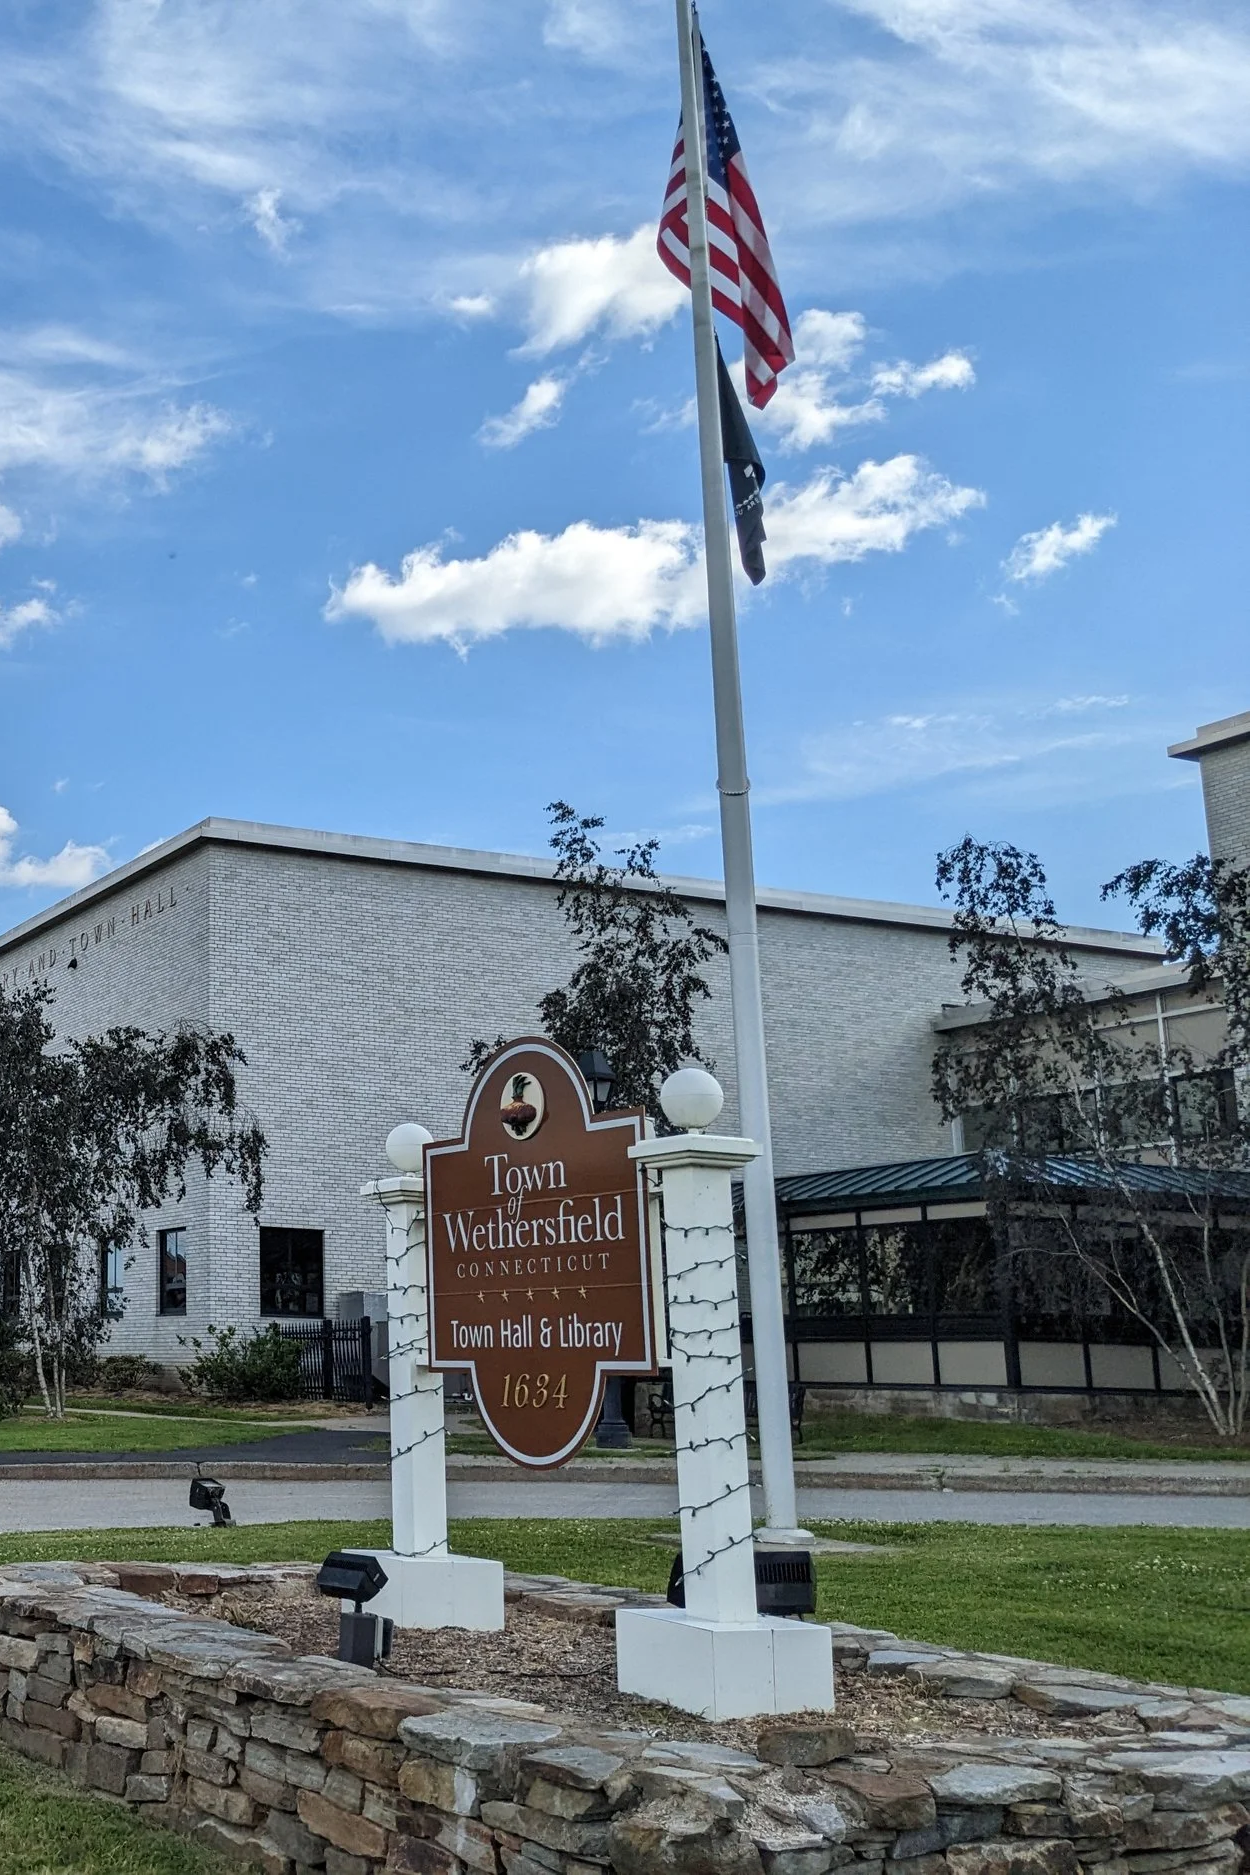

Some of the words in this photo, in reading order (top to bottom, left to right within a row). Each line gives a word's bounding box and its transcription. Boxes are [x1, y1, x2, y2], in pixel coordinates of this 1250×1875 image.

[28, 949, 57, 979] AND
[68, 916, 116, 957] TOWN
[131, 886, 178, 927] HALL
[484, 1153, 568, 1196] Town
[443, 1195, 625, 1253] Wethersfield
[507, 1184, 527, 1225] of
[456, 1252, 610, 1279] CONNECTICUT
[450, 1320, 494, 1349] Town
[500, 1314, 533, 1348] Hall
[540, 1317, 552, 1348] &
[559, 1312, 623, 1357] Library
[500, 1372, 570, 1409] 1634
